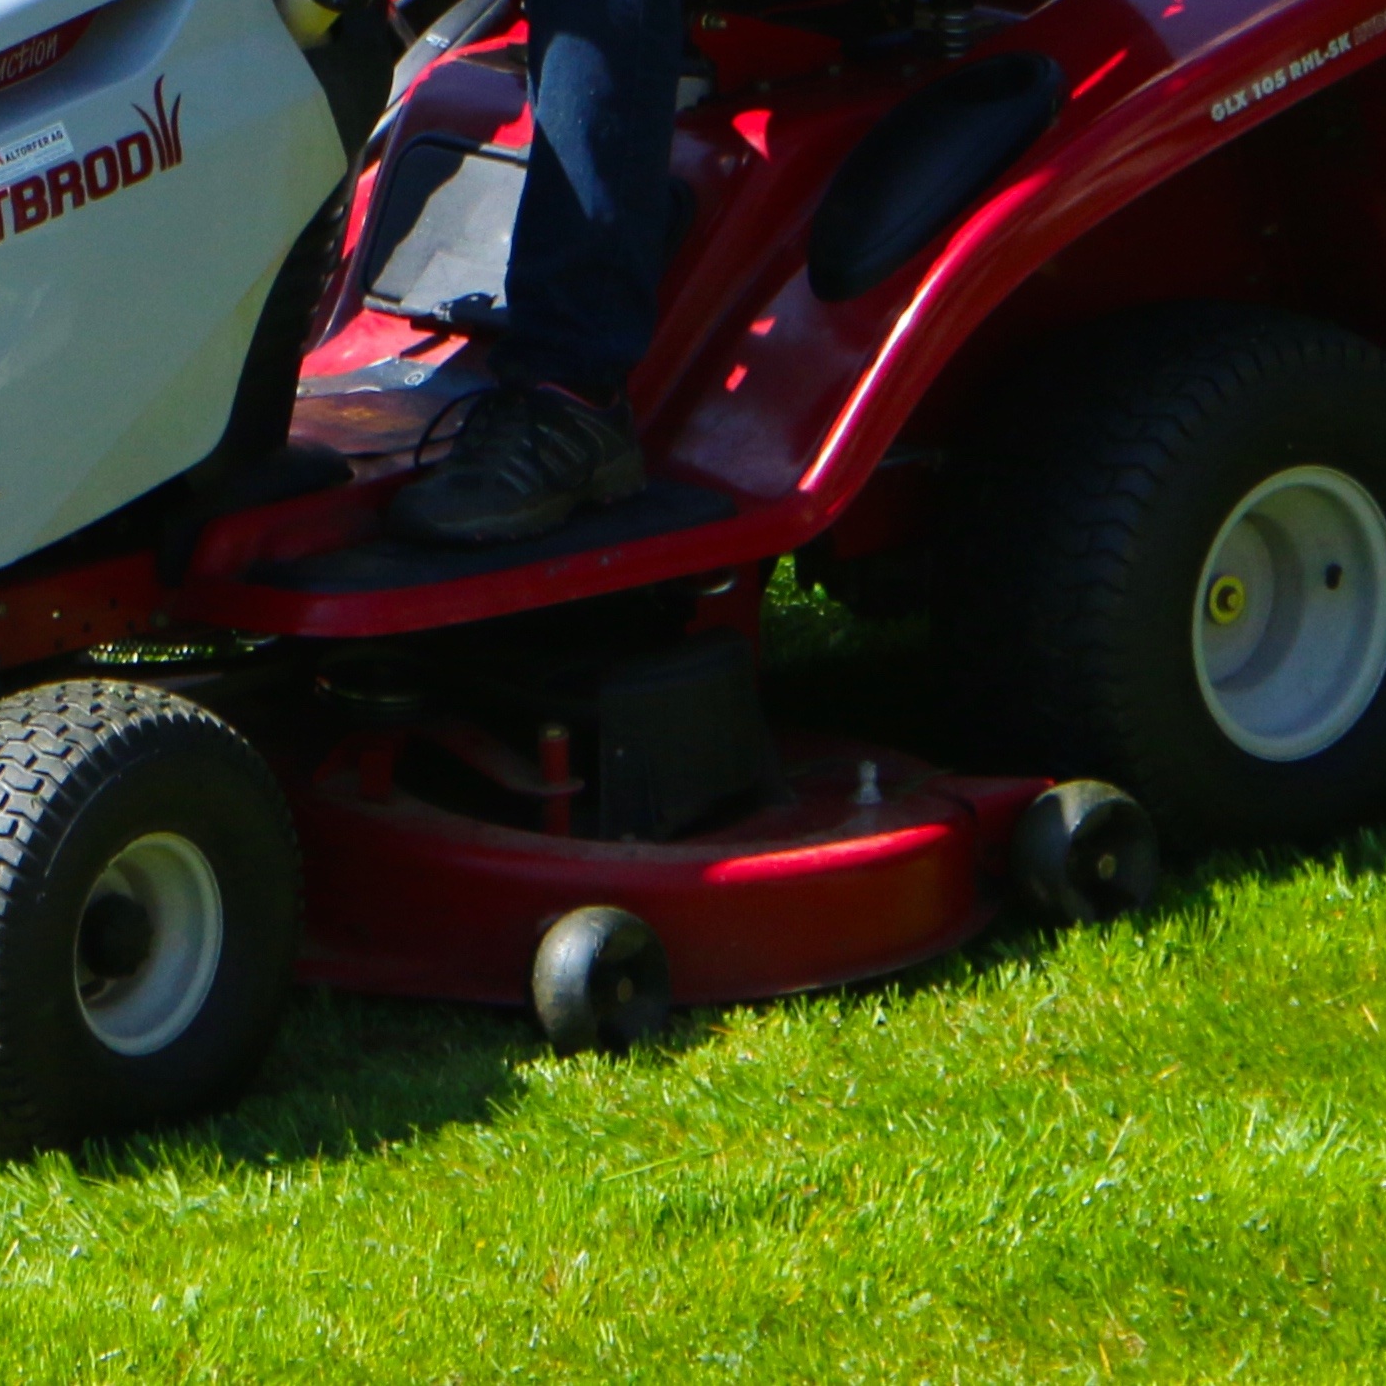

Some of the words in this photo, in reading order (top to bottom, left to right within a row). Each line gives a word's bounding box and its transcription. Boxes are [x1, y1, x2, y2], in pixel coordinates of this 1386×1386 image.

[1252, 69, 1287, 101] 105
[5, 136, 49, 162] ALTORFER
[51, 130, 63, 142] AG
